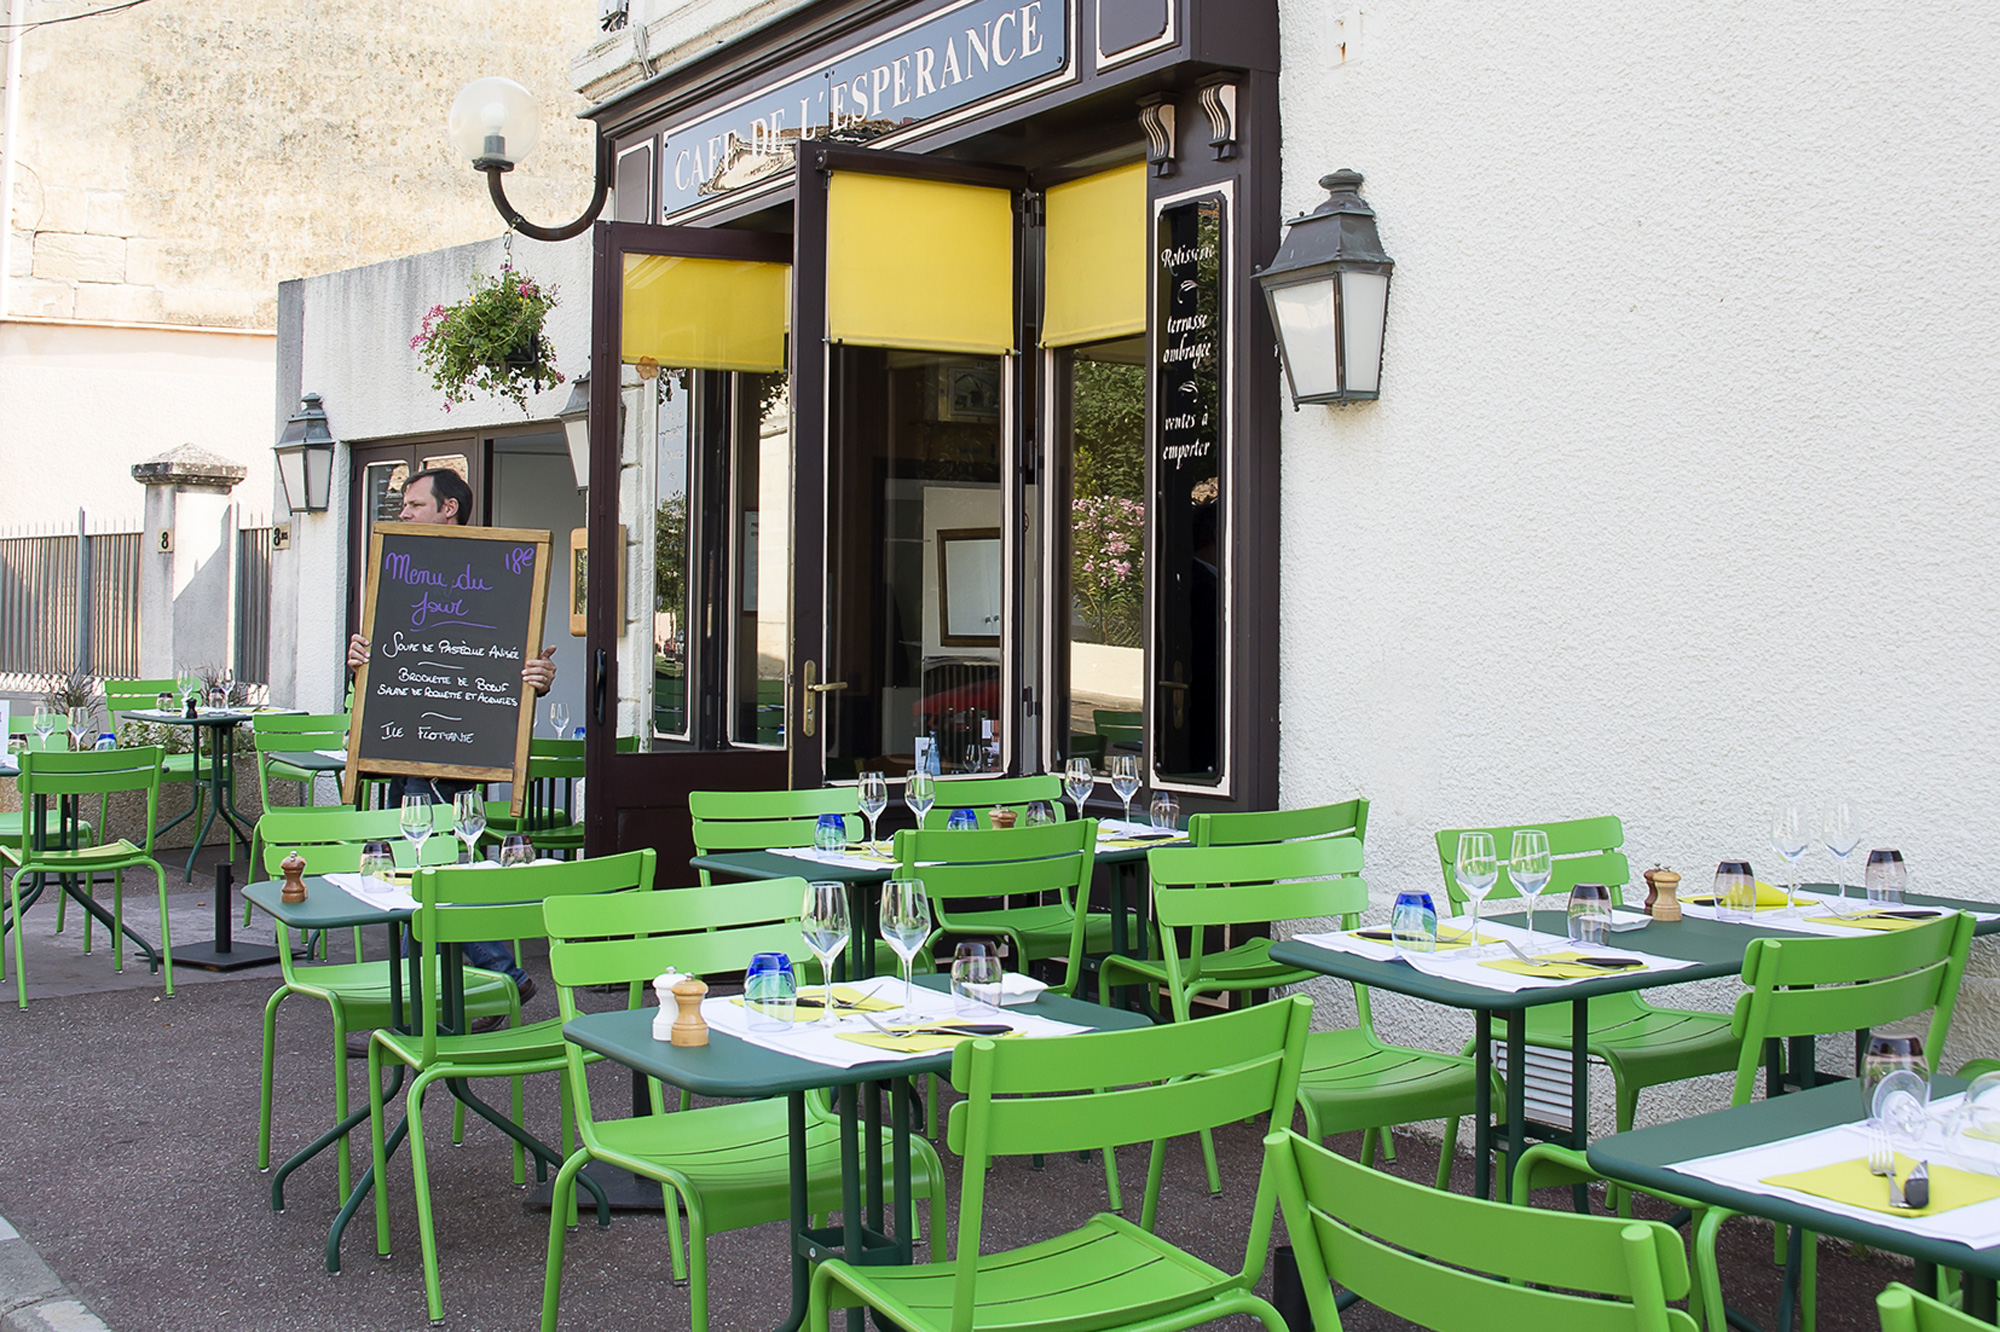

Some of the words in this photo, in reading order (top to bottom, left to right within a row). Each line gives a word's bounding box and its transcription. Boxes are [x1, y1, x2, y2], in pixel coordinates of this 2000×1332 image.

[674, 128, 737, 191] CAFE
[750, 108, 786, 161] DE
[799, 0, 1044, 141] L'ESPERANCE
[1167, 314, 1208, 334] terrasse
[1162, 333, 1212, 370] ombragée
[1165, 413, 1196, 431] ventes
[1201, 404, 1209, 427] à
[1162, 437, 1210, 470] emporter
[161, 531, 169, 549] 8
[384, 552, 447, 586] Menu
[452, 564, 493, 590] du
